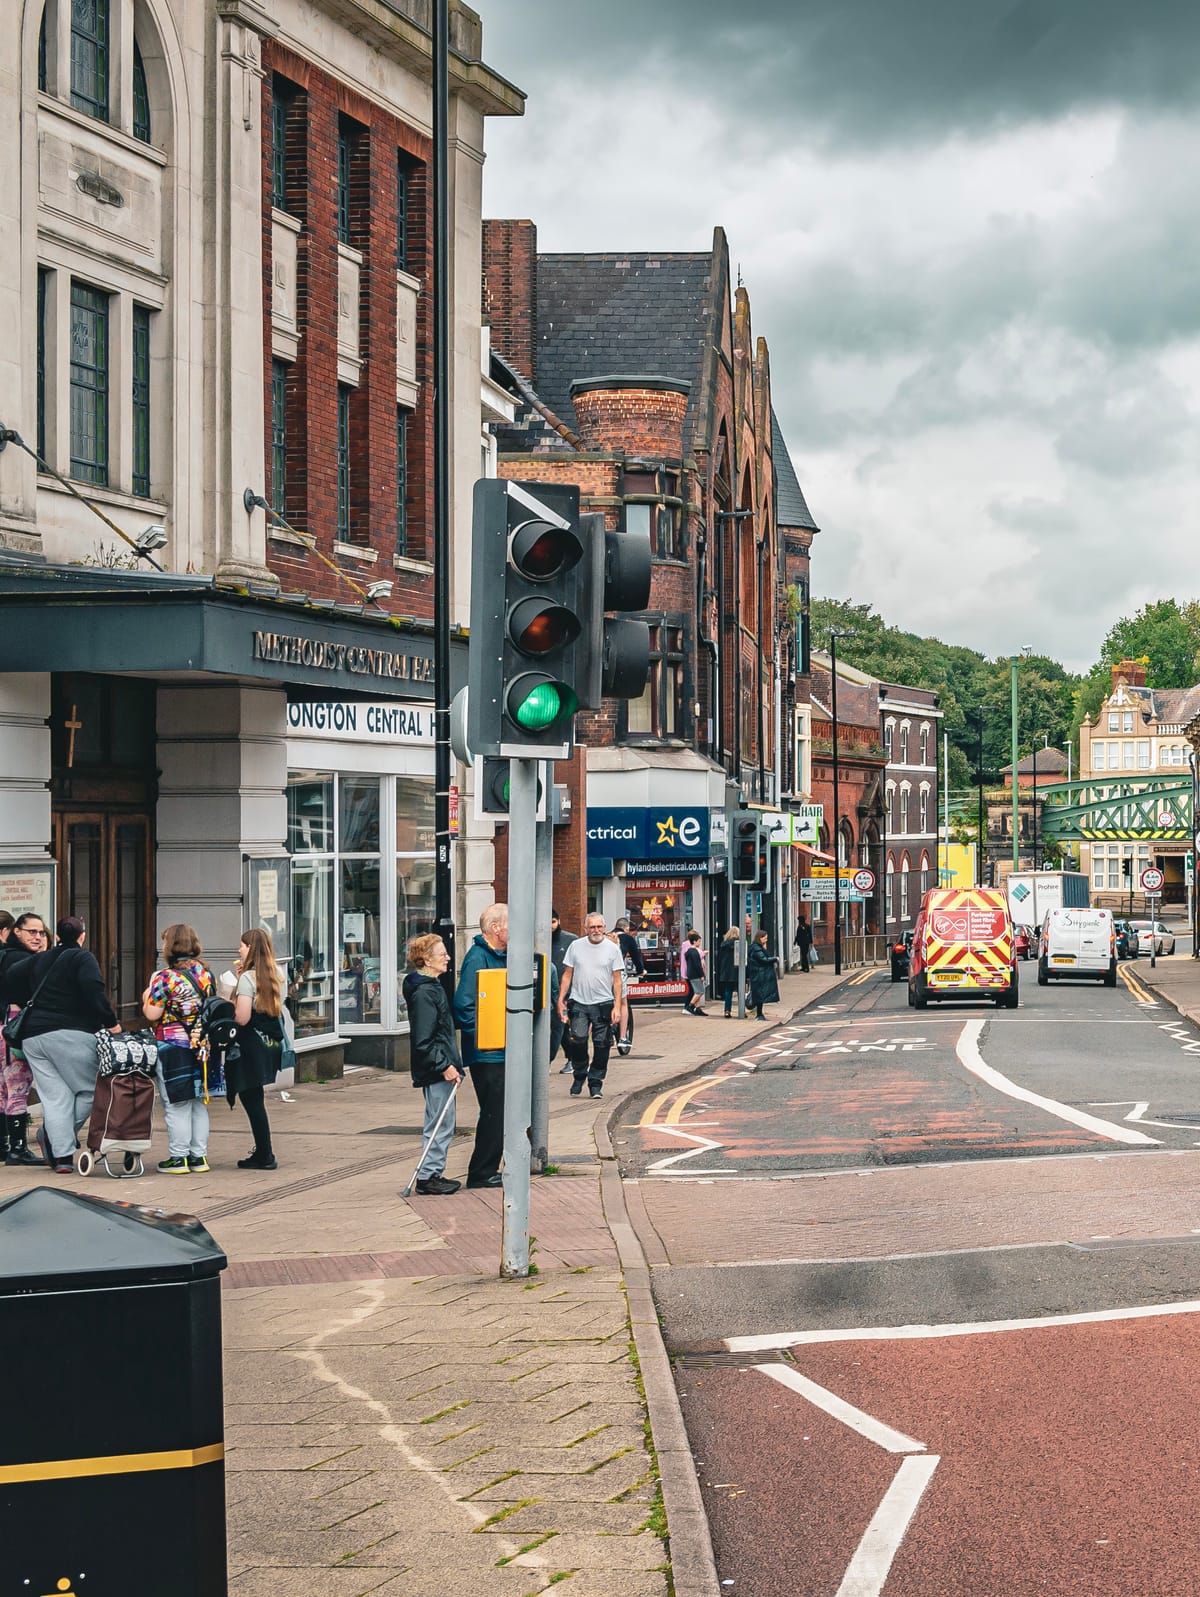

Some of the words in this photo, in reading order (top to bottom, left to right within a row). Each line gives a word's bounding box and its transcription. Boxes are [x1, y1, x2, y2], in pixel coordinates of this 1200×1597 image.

[253, 630, 345, 671] METHODIST
[345, 646, 409, 680] CENTRAL
[411, 656, 435, 683] HA
[287, 703, 357, 732] ONGTON
[367, 706, 422, 737] CENTRAL
[801, 806, 823, 818] HAIR
[627, 860, 708, 875] hylandselectrical.co.uk
[627, 982, 653, 995] Finance
[654, 981, 686, 994] Available
[776, 1043, 937, 1057] LANE
[804, 1037, 927, 1049] BUS
